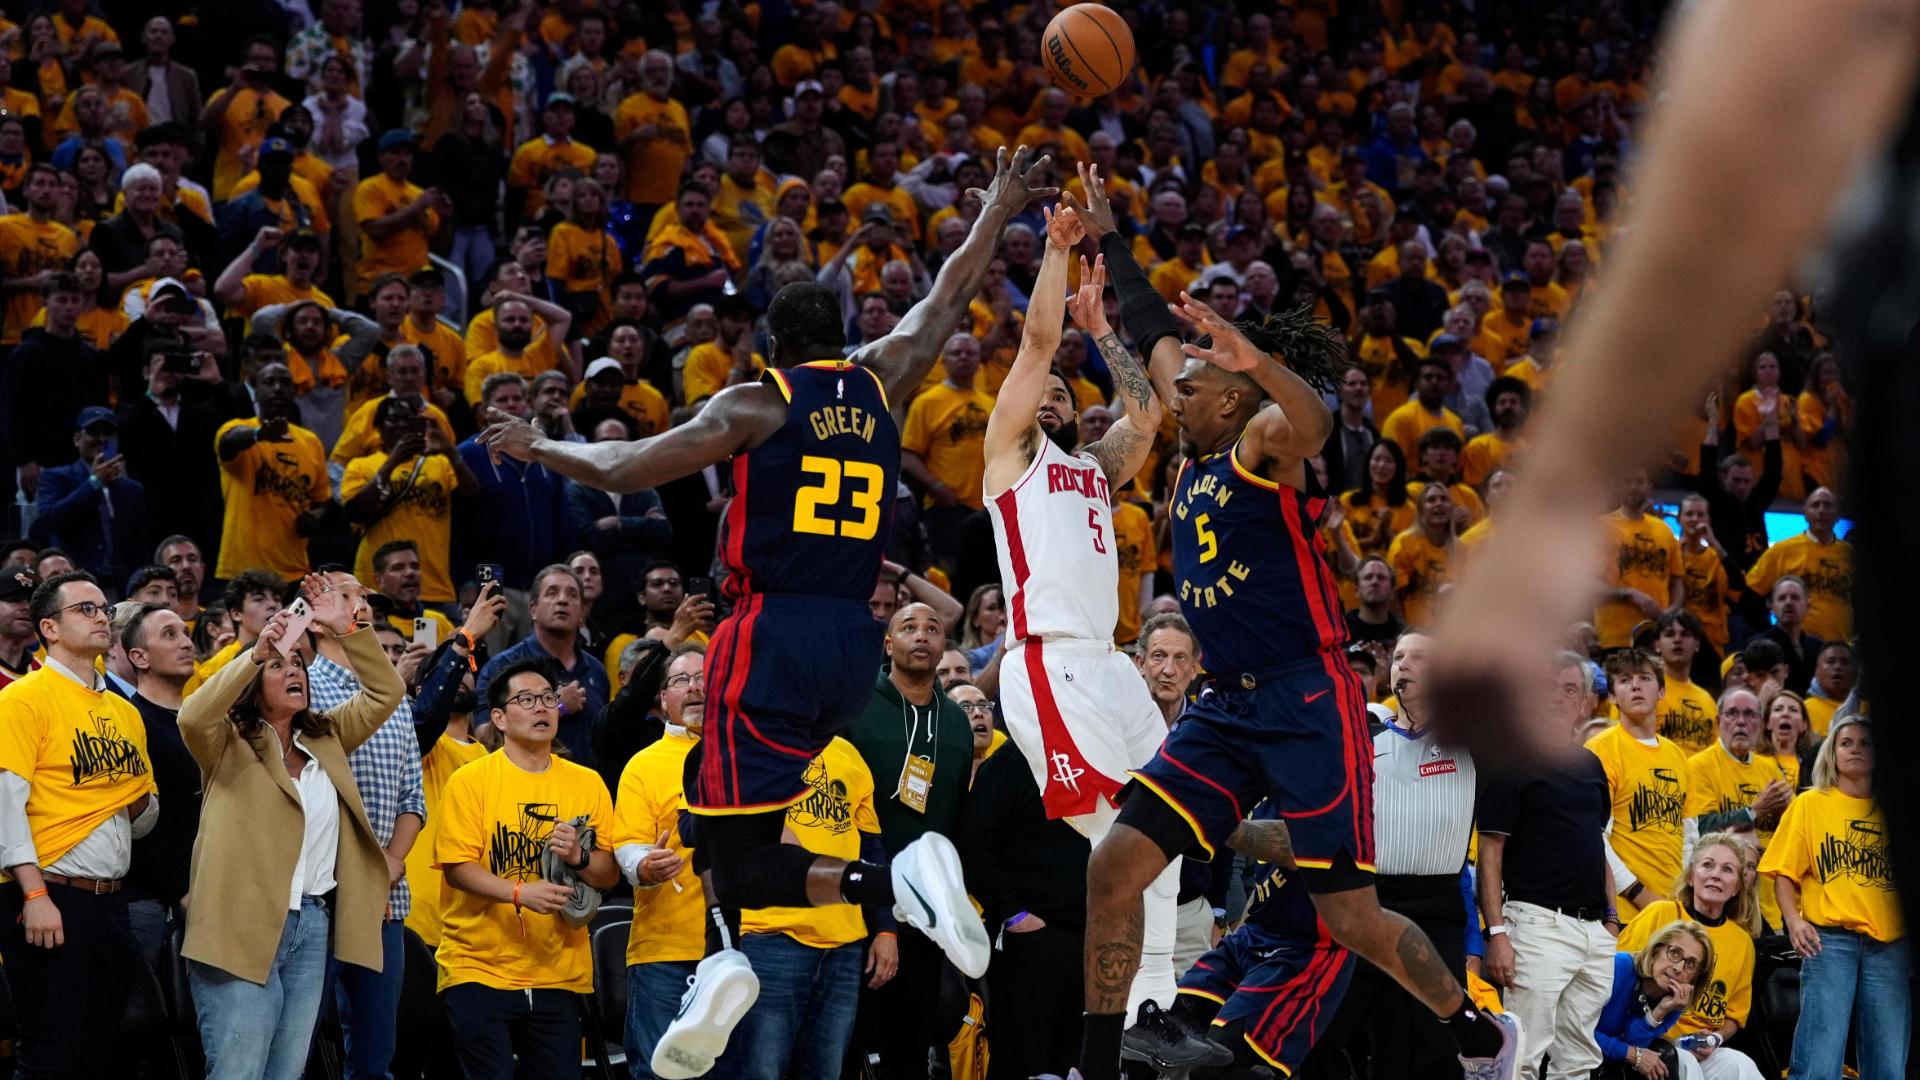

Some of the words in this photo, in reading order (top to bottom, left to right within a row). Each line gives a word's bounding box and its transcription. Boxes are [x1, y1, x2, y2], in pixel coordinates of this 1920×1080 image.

[809, 405, 876, 444] GREEN
[792, 455, 884, 541] 23
[1047, 463, 1109, 508] ROCKT
[1088, 507, 1106, 555] 5
[1195, 512, 1218, 564] 5
[1180, 559, 1250, 608] STATE
[1420, 761, 1456, 776] Emirates
[1254, 868, 1287, 902] ATE
